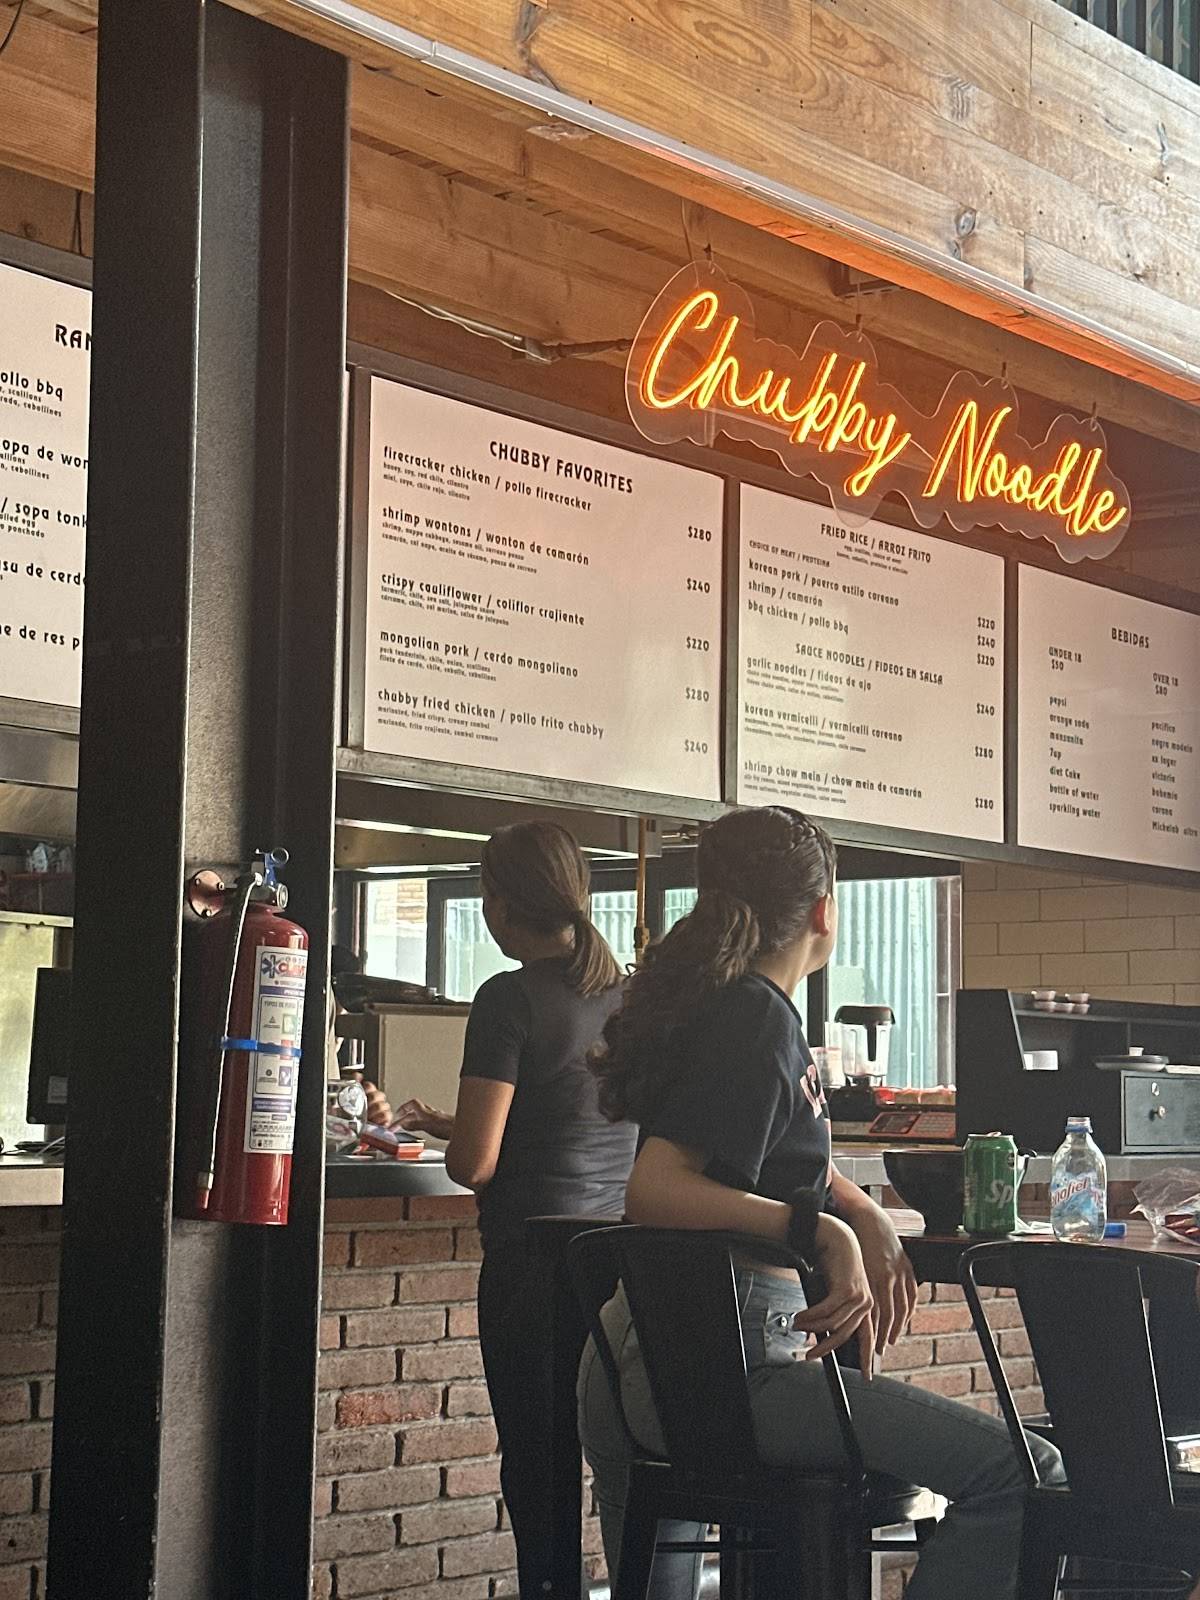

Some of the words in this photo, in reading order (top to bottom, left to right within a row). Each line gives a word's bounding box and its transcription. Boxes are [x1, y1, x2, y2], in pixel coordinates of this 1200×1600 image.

[36, 378, 63, 402] bbq
[639, 290, 913, 497] Chubby
[922, 399, 1128, 536] Noodle
[36, 445, 54, 462] de
[383, 445, 445, 473] firecracker
[449, 464, 491, 485] chicken
[494, 476, 501, 490] /
[504, 480, 532, 496] pollo
[536, 486, 592, 511] firecracker
[489, 440, 551, 473] CHUBBY
[556, 458, 633, 494] FAVORITES
[15, 503, 50, 521] sopa
[382, 505, 420, 528] shrimp
[424, 517, 471, 538] wontons
[475, 528, 482, 543] /
[485, 532, 525, 551] wonton
[529, 541, 542, 555] de
[545, 547, 589, 566] camarón
[687, 525, 712, 542] $280
[820, 523, 847, 540] FRIED
[849, 531, 869, 547] RICE
[870, 537, 876, 550] /
[878, 539, 906, 557] ARROZ
[908, 547, 931, 564] FRITO
[0, 560, 18, 574] su
[25, 562, 44, 579] de
[50, 570, 85, 587] cerd
[748, 558, 778, 576] korean
[781, 569, 801, 582] pork
[803, 572, 809, 586] /
[811, 576, 839, 592] puerco
[841, 584, 865, 598] estilo
[867, 591, 899, 607] coreano
[686, 577, 711, 594] $240
[748, 579, 777, 598] shrimp
[778, 587, 785, 600] /
[787, 591, 823, 607] camarón
[381, 572, 415, 593] crispy
[419, 582, 482, 604] cauliflower
[486, 594, 492, 609] /
[496, 598, 535, 615] coliflor
[538, 608, 585, 626] crujiente
[747, 598, 764, 616] bbq
[766, 604, 799, 621] chicken
[801, 612, 806, 625] /
[808, 615, 831, 629] pollo
[833, 619, 849, 635] bbq
[977, 616, 996, 631] $220
[0, 624, 12, 637] e
[18, 625, 37, 641] de
[43, 632, 65, 646] res
[686, 636, 710, 652] $220
[977, 634, 996, 649] $240
[1111, 627, 1150, 649] BEBIDAS
[380, 631, 440, 652] mongolian
[444, 643, 469, 657] pork
[473, 647, 480, 662] /
[483, 651, 513, 665] cerdo
[517, 657, 578, 678] mongoliano
[795, 642, 823, 659] SAUCE
[826, 649, 865, 668] NOODLES
[867, 659, 873, 671] /
[874, 660, 904, 677] FIDEOS
[906, 667, 917, 680] EN
[919, 670, 943, 686] SALSA
[976, 653, 995, 667] $220
[1048, 646, 1073, 662] UNDER
[1074, 652, 1082, 664] 18
[1051, 658, 1065, 671] $50
[746, 656, 772, 670] garlic
[774, 662, 807, 678] noodles
[809, 668, 815, 681] /
[817, 669, 843, 685] fideos
[845, 675, 856, 688] de
[858, 679, 872, 691] ajo
[1152, 672, 1170, 686] OVER
[1171, 676, 1179, 687] 18
[685, 686, 710, 703] $280
[1049, 696, 1067, 708] pepsi
[377, 688, 419, 709] chubby
[423, 695, 450, 712] fried
[454, 701, 496, 719] chicken
[500, 708, 506, 723] /
[510, 712, 537, 726] pollo
[541, 715, 564, 730] frito
[568, 720, 604, 740] chubby
[976, 702, 995, 717] $240
[744, 702, 774, 718] korean
[777, 711, 819, 726] vermicelli
[821, 717, 827, 730] /
[828, 721, 869, 736] vermicelli
[871, 728, 903, 742] coreano
[684, 738, 709, 755] $240
[974, 745, 994, 759] $280
[744, 760, 773, 777] shrimp
[775, 765, 798, 779] chow
[800, 770, 821, 783] mein
[823, 772, 829, 786] /
[831, 773, 854, 788] chow
[855, 779, 875, 791] mein
[877, 781, 887, 793] de
[974, 797, 994, 810] $280
